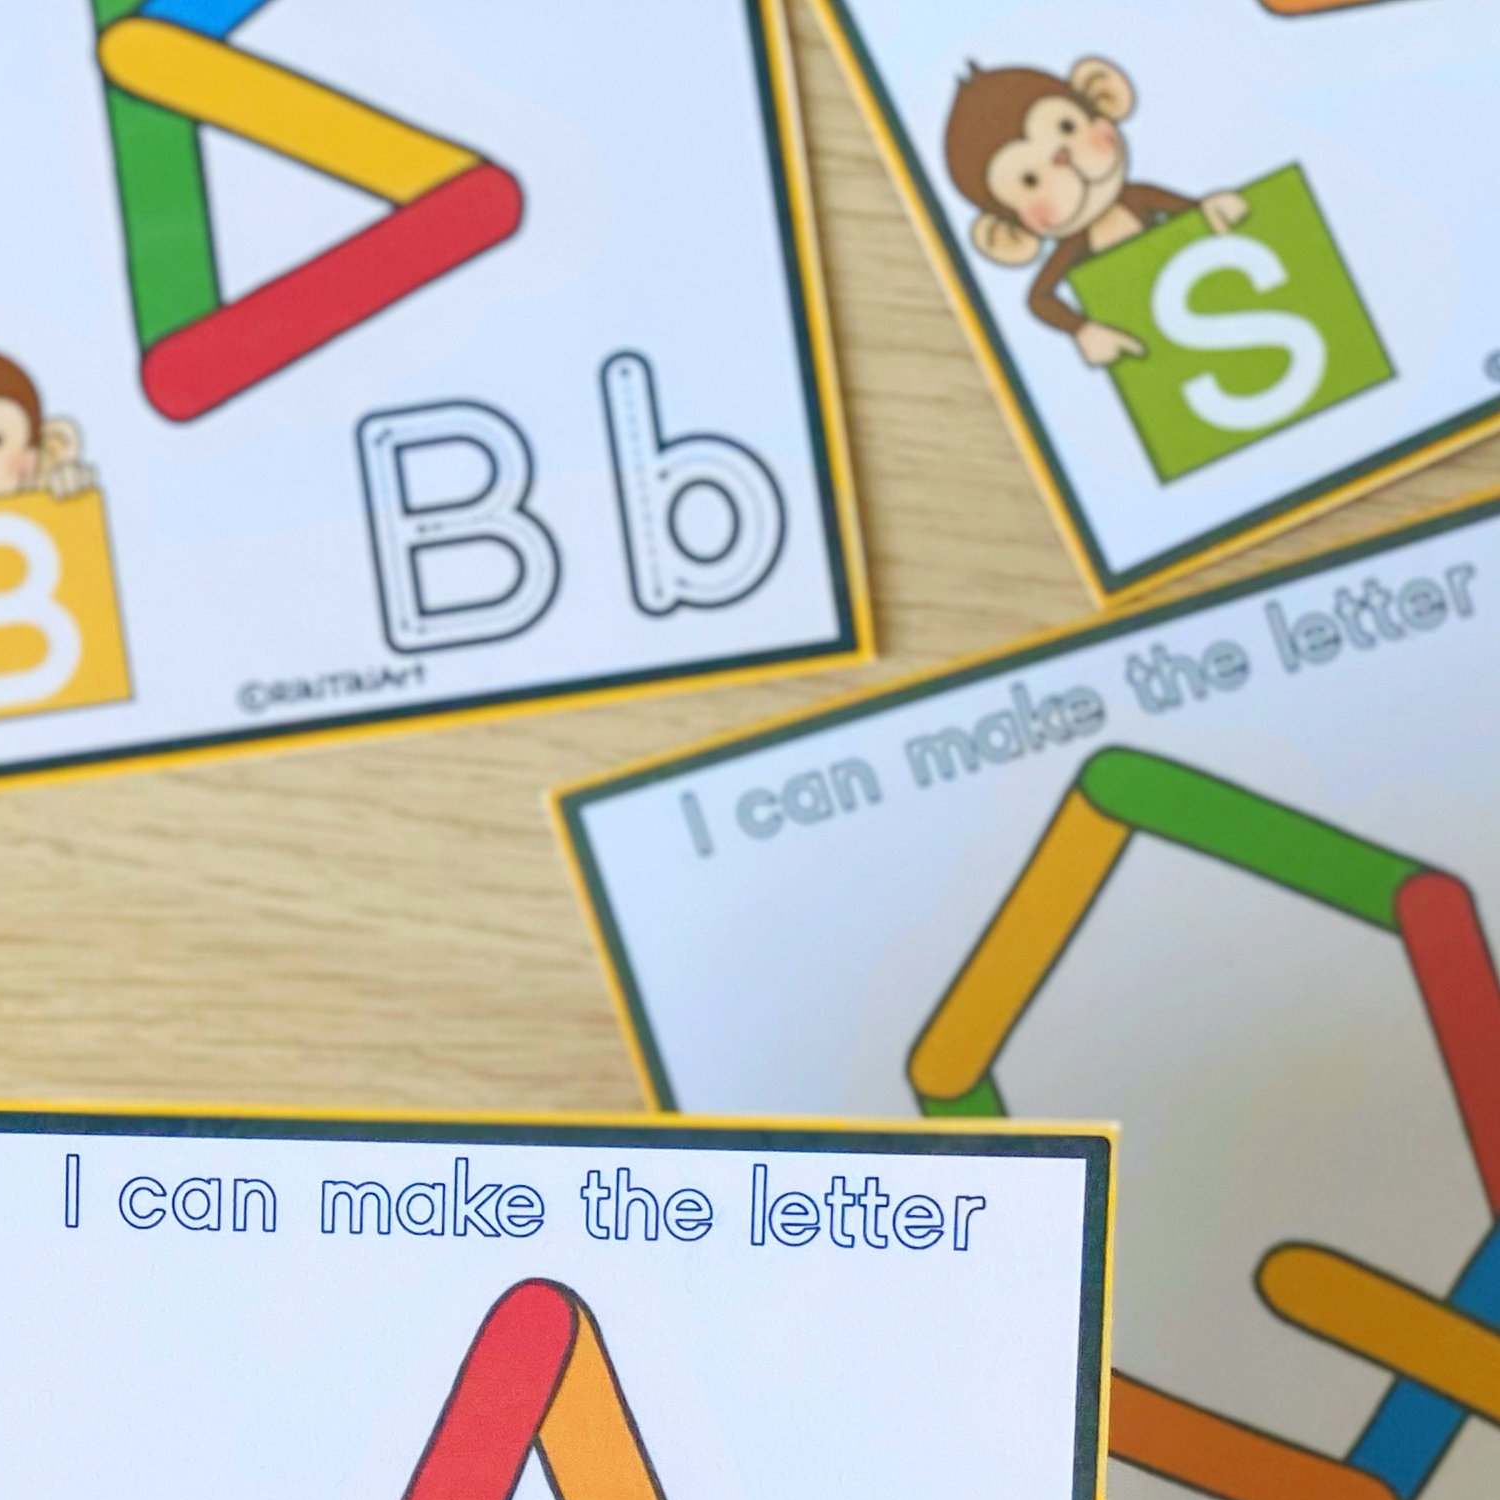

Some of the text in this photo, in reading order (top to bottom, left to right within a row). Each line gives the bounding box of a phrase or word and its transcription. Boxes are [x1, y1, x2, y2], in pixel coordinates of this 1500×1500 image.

[1151, 233, 1327, 430] S
[353, 351, 786, 653] B b
[734, 757, 883, 840] can
[904, 682, 1106, 789] make
[1124, 637, 1250, 717] the
[1264, 562, 1477, 674] letter
[118, 1174, 277, 1232] can
[319, 1157, 547, 1239] make
[580, 1167, 714, 1242] the
[750, 1163, 987, 1252] letter
